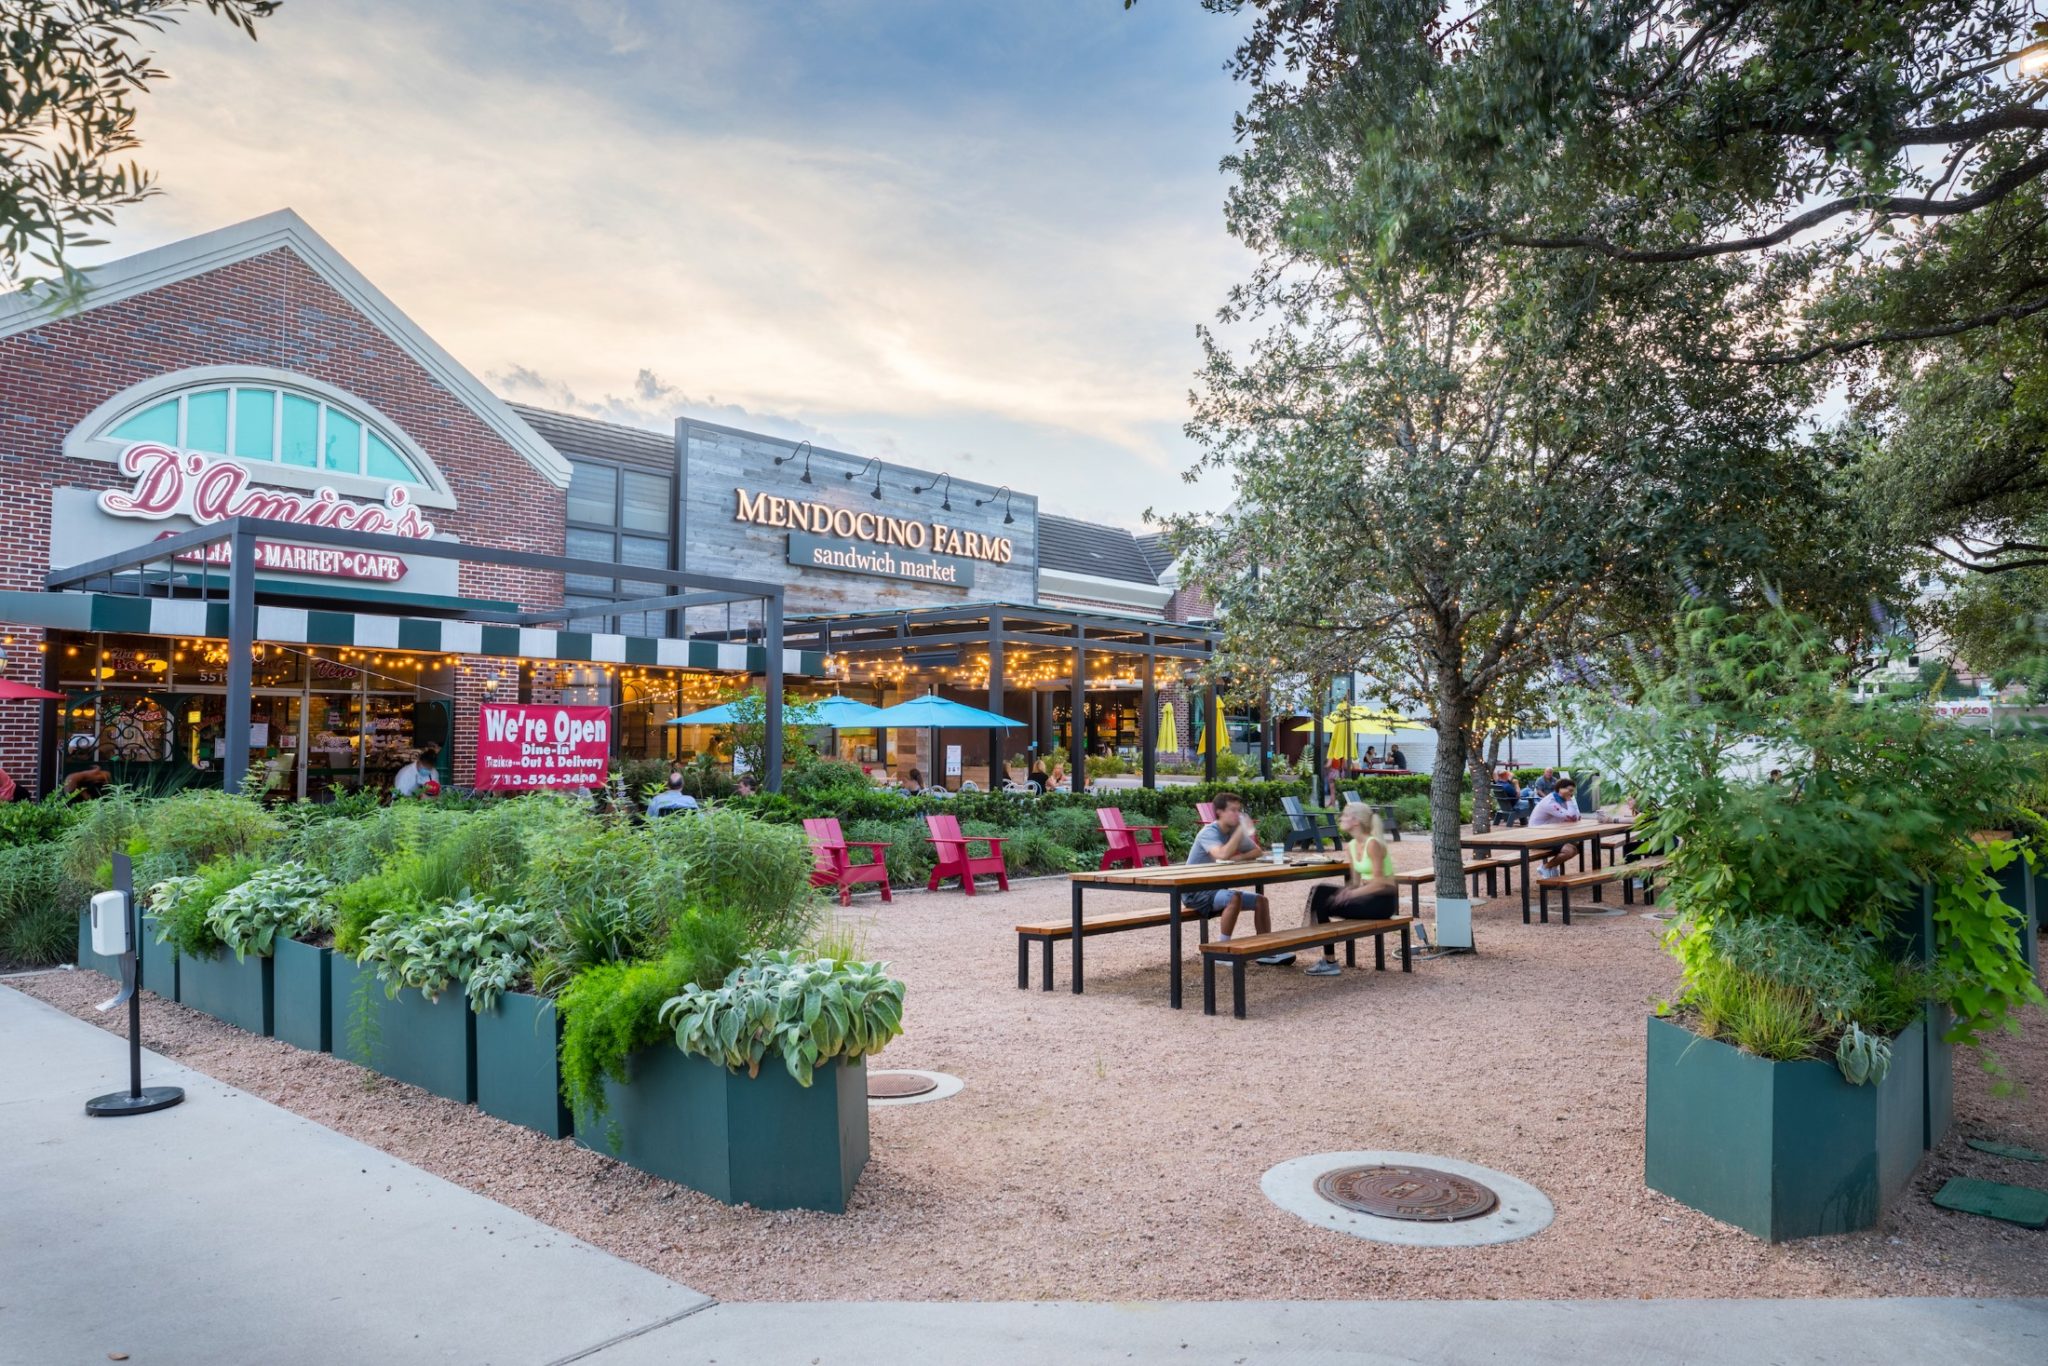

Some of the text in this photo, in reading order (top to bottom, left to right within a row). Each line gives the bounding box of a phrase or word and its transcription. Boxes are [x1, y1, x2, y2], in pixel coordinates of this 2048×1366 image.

[104, 443, 431, 539] D'Amico's
[735, 487, 1012, 563] MENDOCINO FARMS
[264, 543, 343, 573] MARKET
[353, 554, 400, 579] CAFE
[813, 546, 957, 583] sandwich market
[112, 658, 156, 671] Beer
[314, 661, 358, 679] Vino
[485, 709, 606, 751] We're Open
[521, 742, 570, 756] Dine-In
[545, 756, 555, 768] &
[557, 755, 604, 770] Delivery
